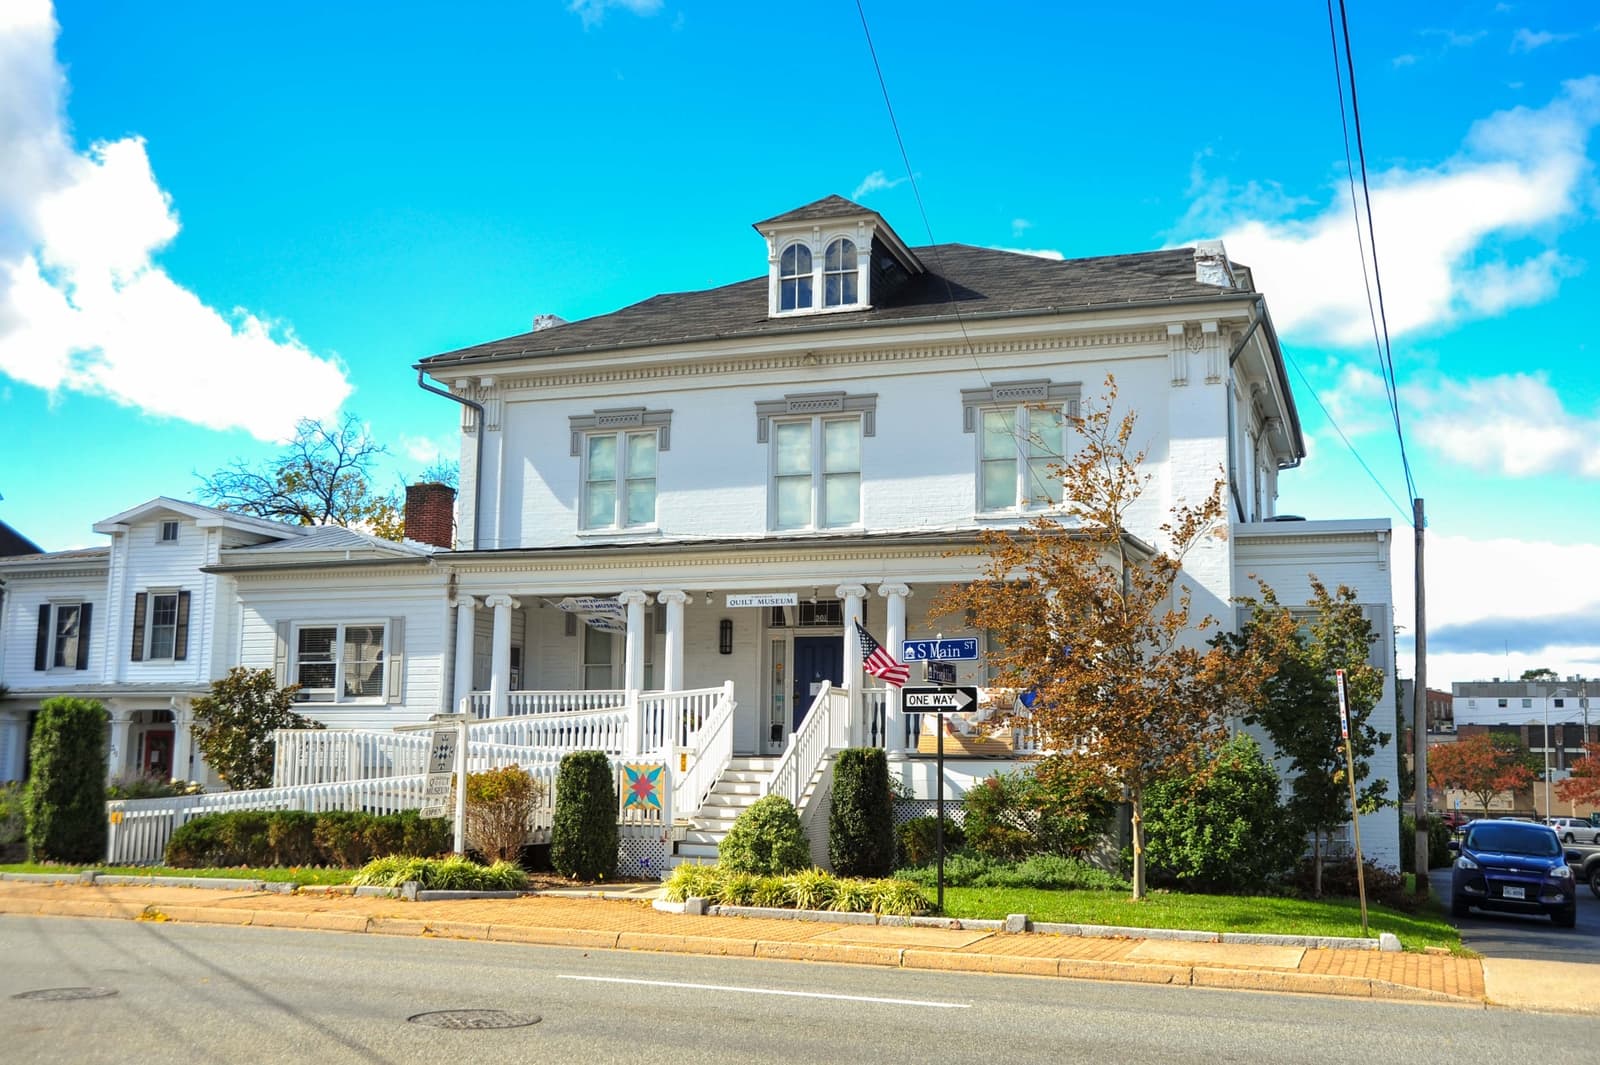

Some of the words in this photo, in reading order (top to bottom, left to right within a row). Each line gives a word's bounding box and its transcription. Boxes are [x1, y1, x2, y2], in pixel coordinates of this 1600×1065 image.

[917, 643, 927, 658] S
[930, 642, 960, 658] Main
[964, 641, 975, 649] ST
[909, 695, 929, 705] ONE
[933, 695, 954, 705] WAY
[425, 808, 442, 817] OPEN
